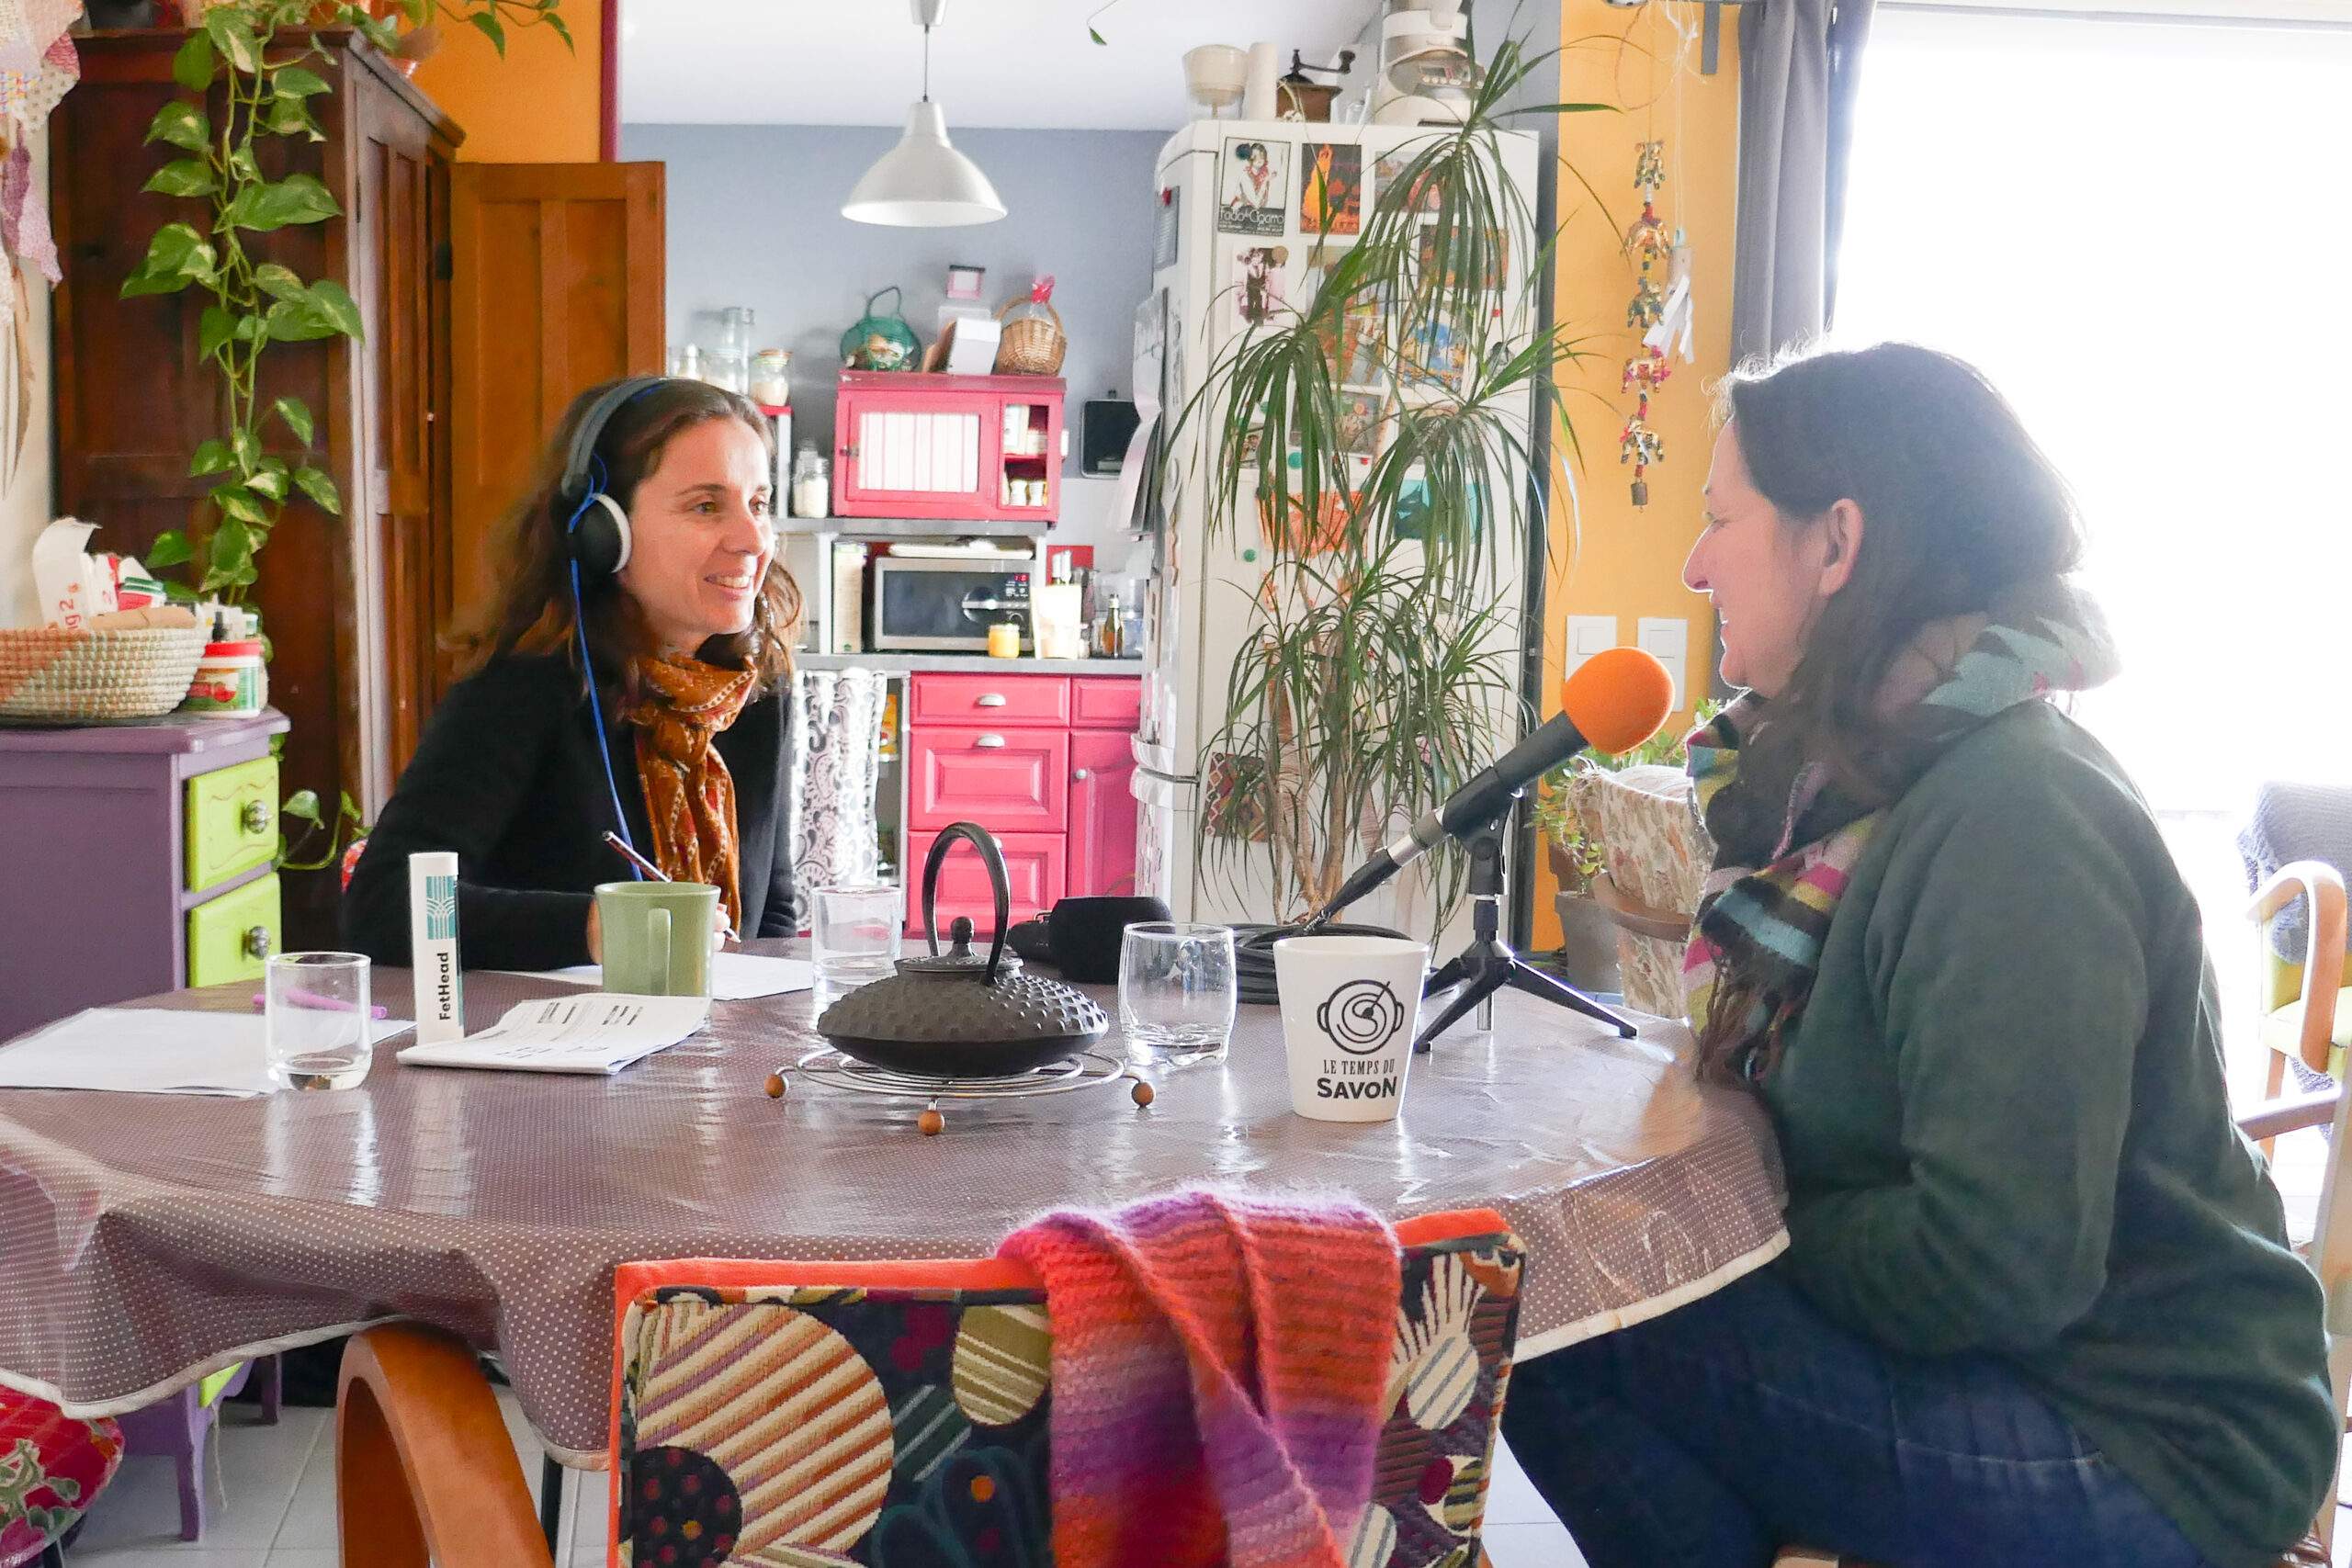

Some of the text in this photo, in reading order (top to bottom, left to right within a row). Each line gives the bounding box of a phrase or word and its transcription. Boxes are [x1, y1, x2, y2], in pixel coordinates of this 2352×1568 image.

[436, 952, 451, 1021] FetHead
[1323, 1058, 1395, 1075] LE TEMPS DU
[1317, 1076, 1397, 1100] SAVON
